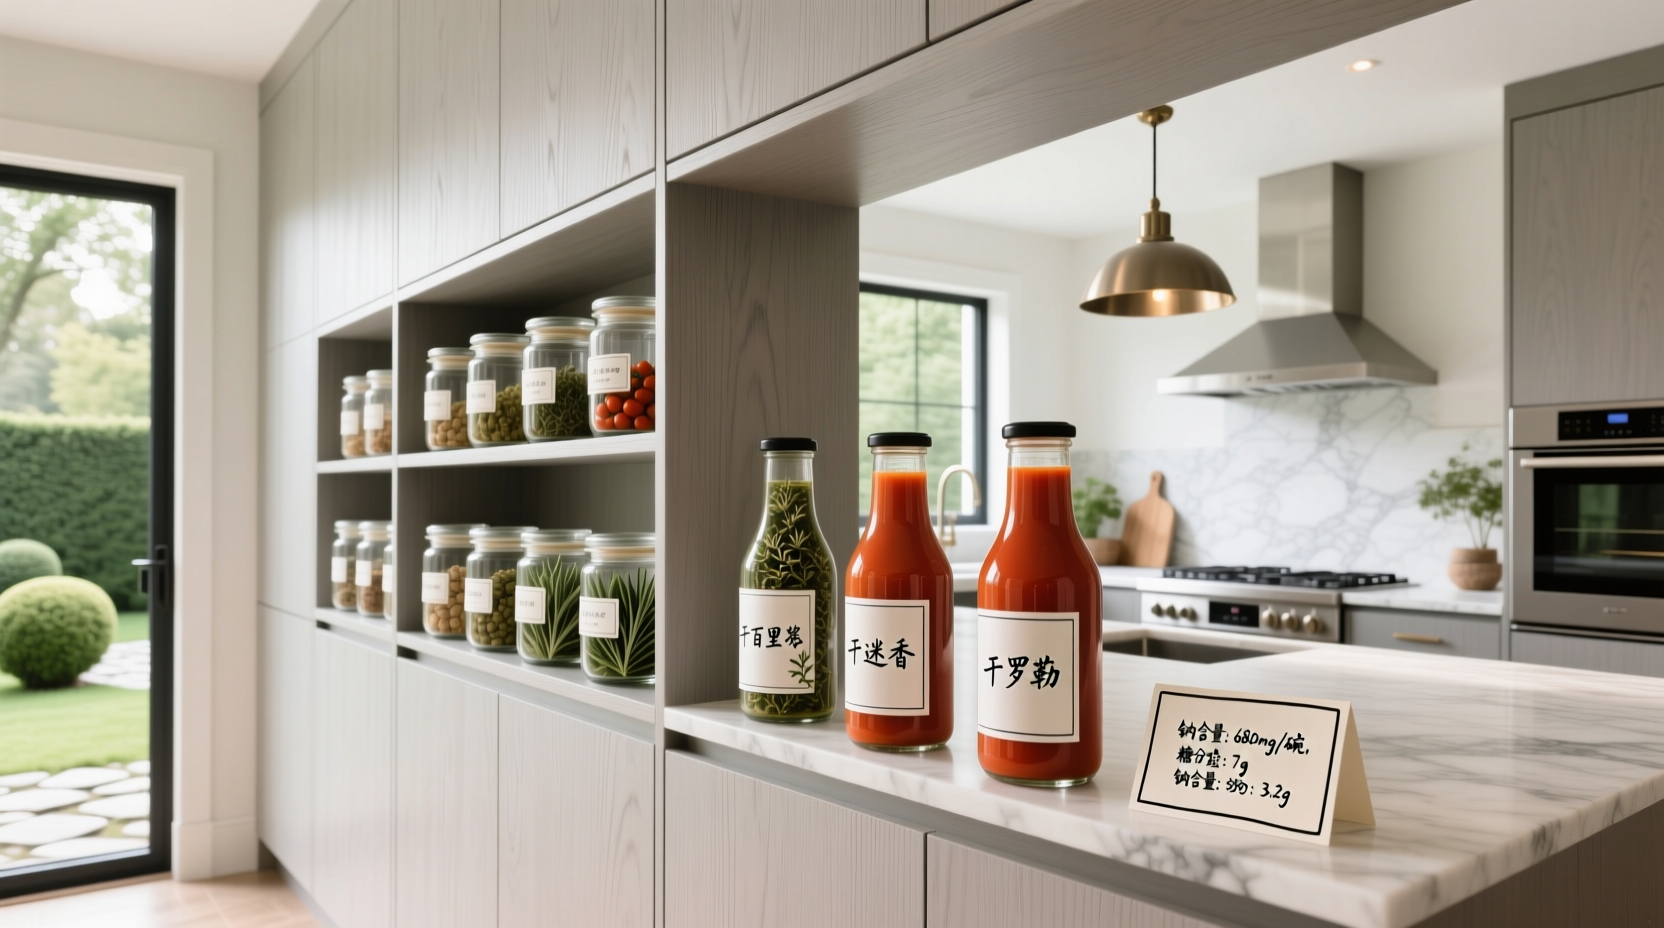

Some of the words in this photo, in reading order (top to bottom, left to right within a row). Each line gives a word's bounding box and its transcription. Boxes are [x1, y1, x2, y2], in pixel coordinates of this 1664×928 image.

[847, 637, 916, 671] 干迷香
[983, 654, 1061, 690] 干罗勒
[1232, 754, 1249, 778] 7g
[1259, 781, 1291, 809] 3.2g
